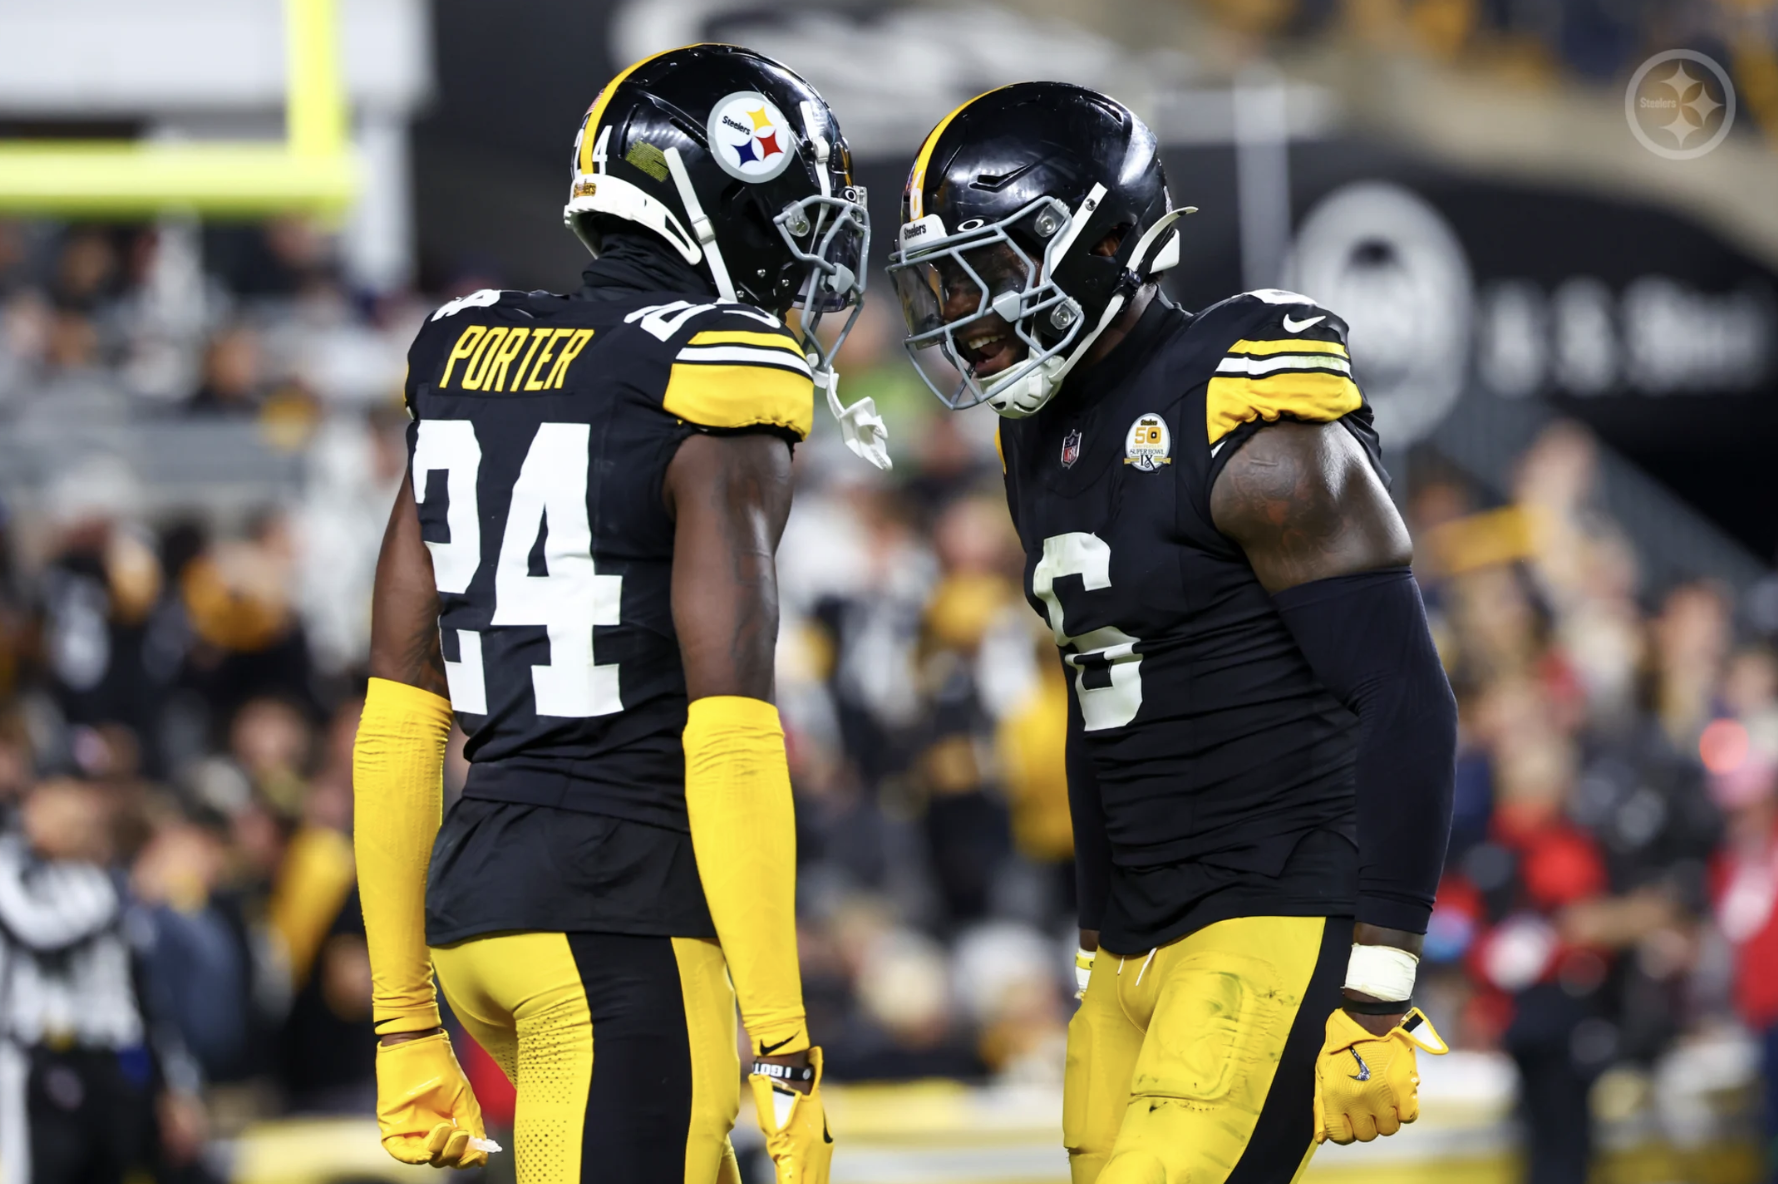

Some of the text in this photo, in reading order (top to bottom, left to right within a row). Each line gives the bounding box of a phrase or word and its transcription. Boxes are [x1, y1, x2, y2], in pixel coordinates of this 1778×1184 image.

[721, 114, 752, 136] Steelers
[910, 170, 923, 220] 6
[904, 224, 926, 240] Steelers
[439, 325, 595, 392] PORTER
[1134, 427, 1161, 444] 50
[1140, 454, 1157, 470] IX
[412, 419, 624, 718] 24
[1033, 531, 1144, 732] 6
